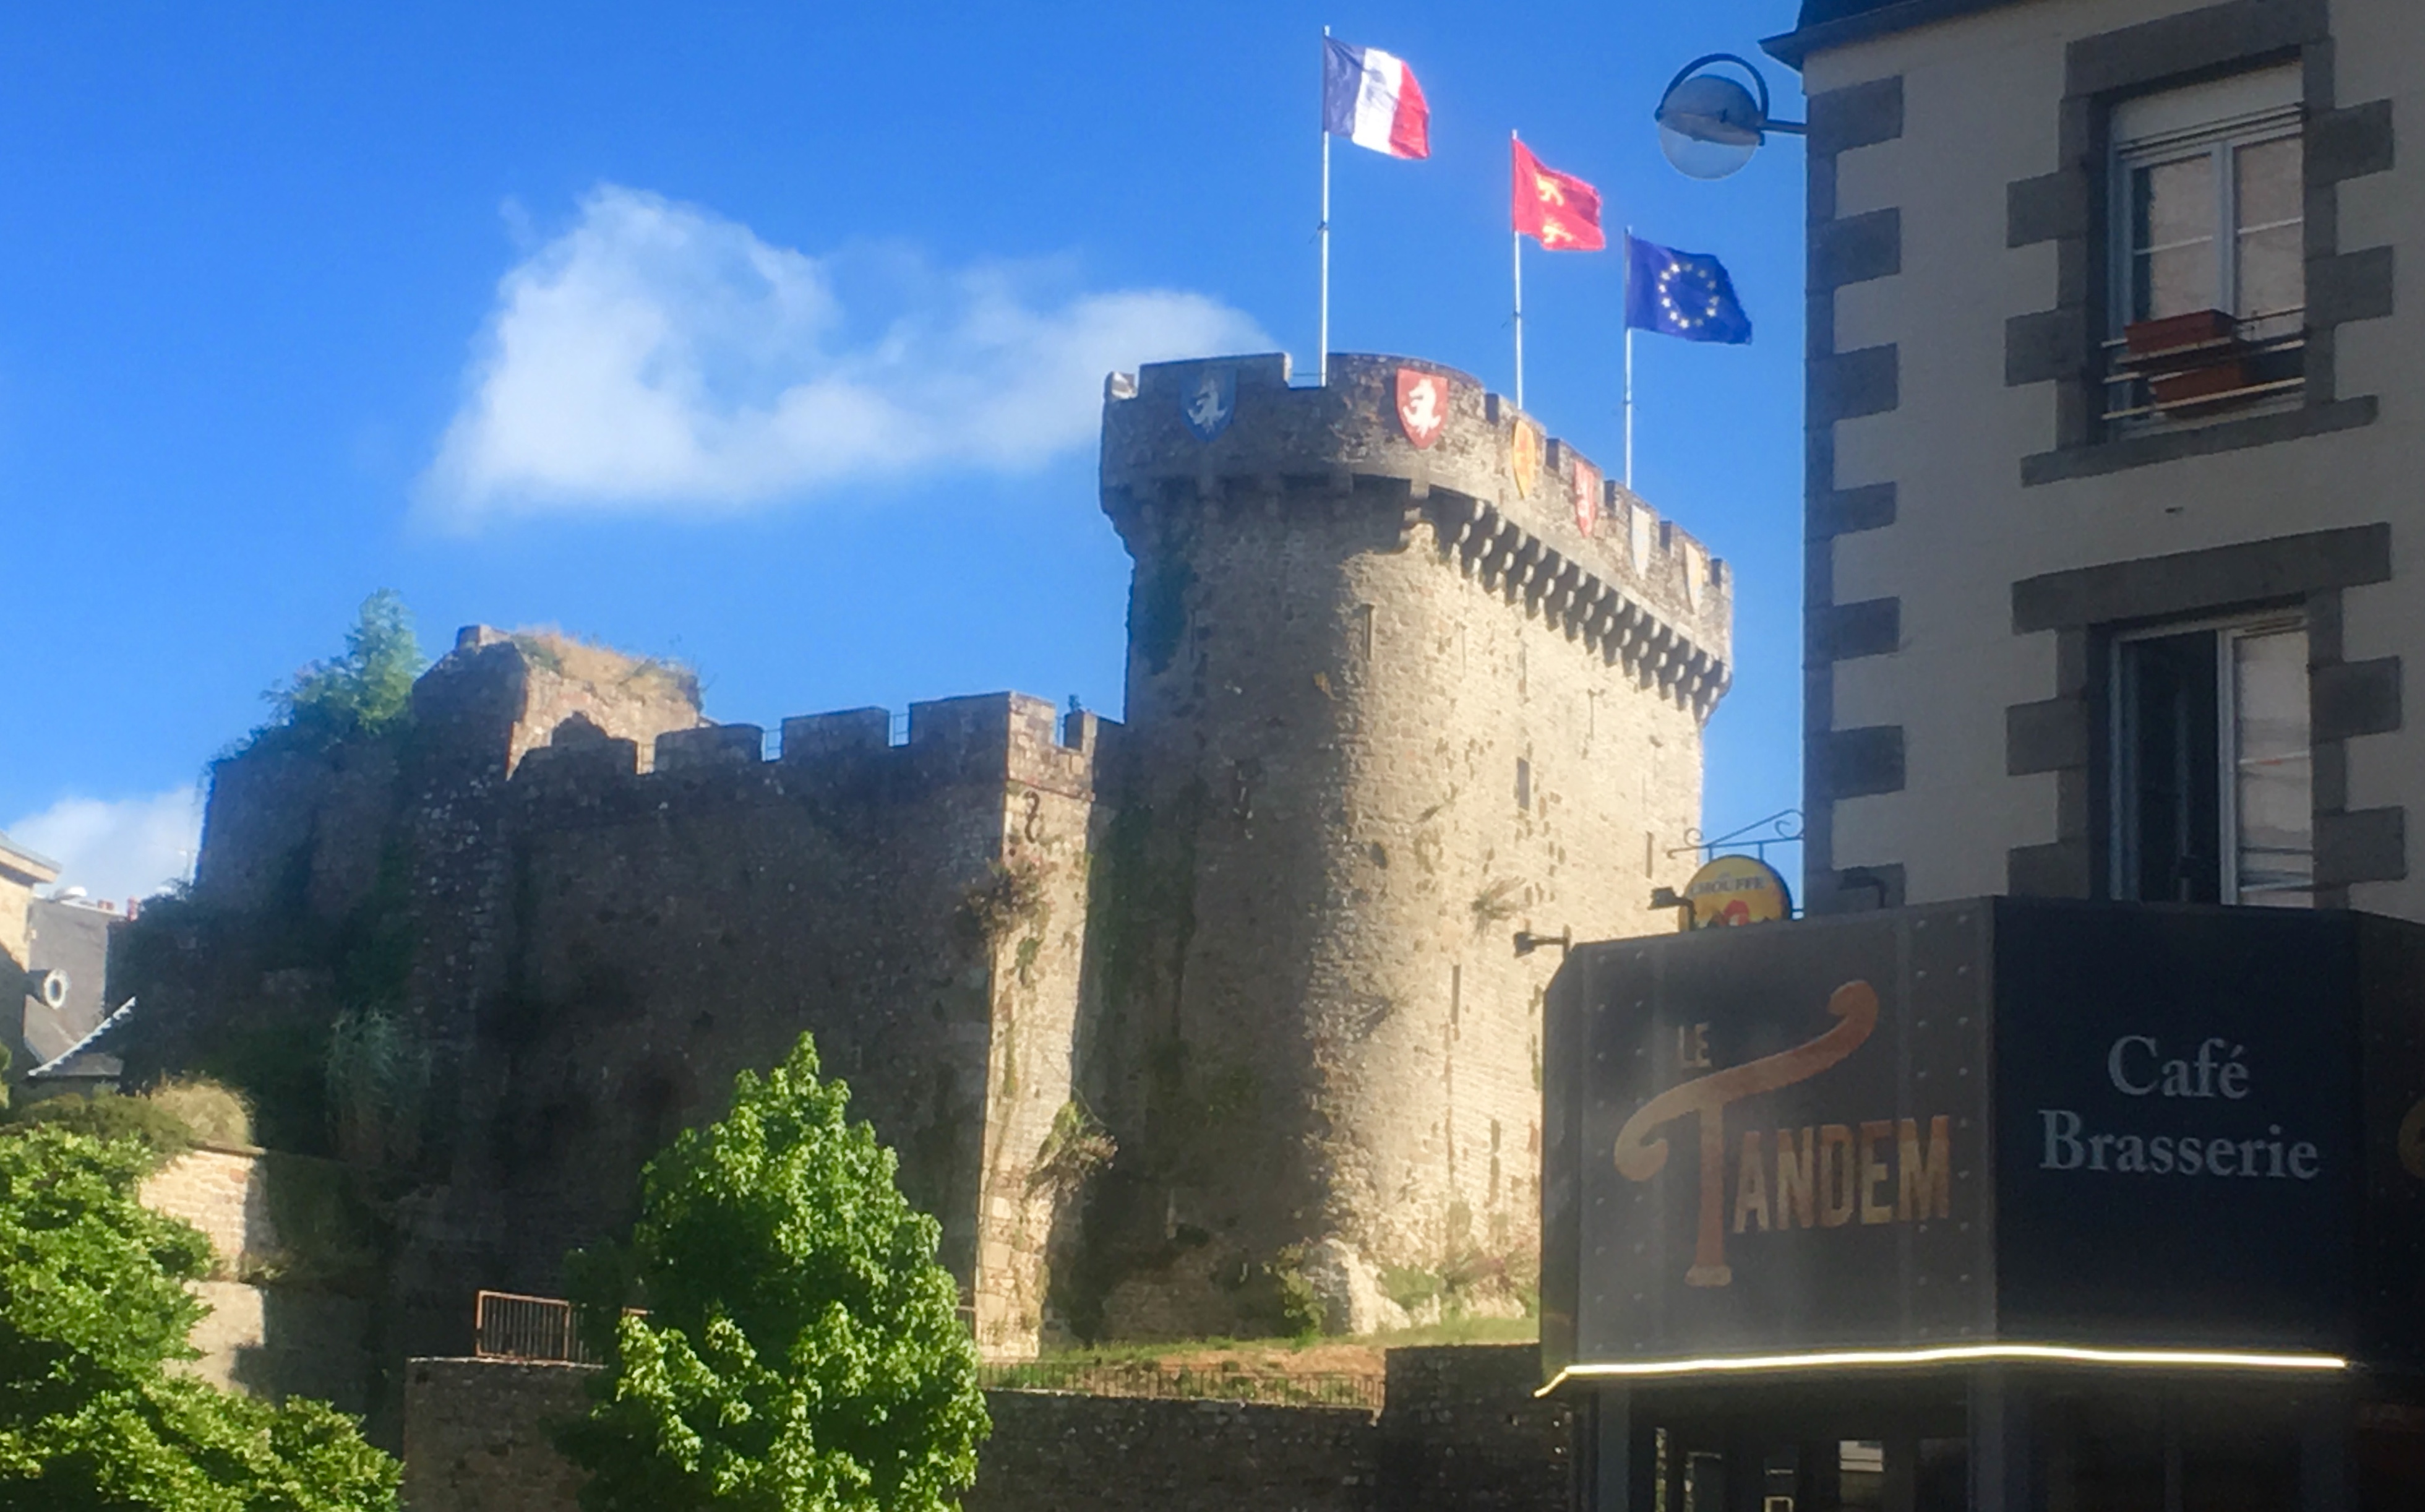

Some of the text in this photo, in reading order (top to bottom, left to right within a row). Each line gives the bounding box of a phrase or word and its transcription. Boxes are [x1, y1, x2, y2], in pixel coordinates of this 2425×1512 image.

[1678, 1022, 1712, 1068] LE
[2108, 1034, 2250, 1099] Café
[1613, 979, 1950, 1288] TANDEM
[2038, 1109, 2322, 1179] Brasserie
